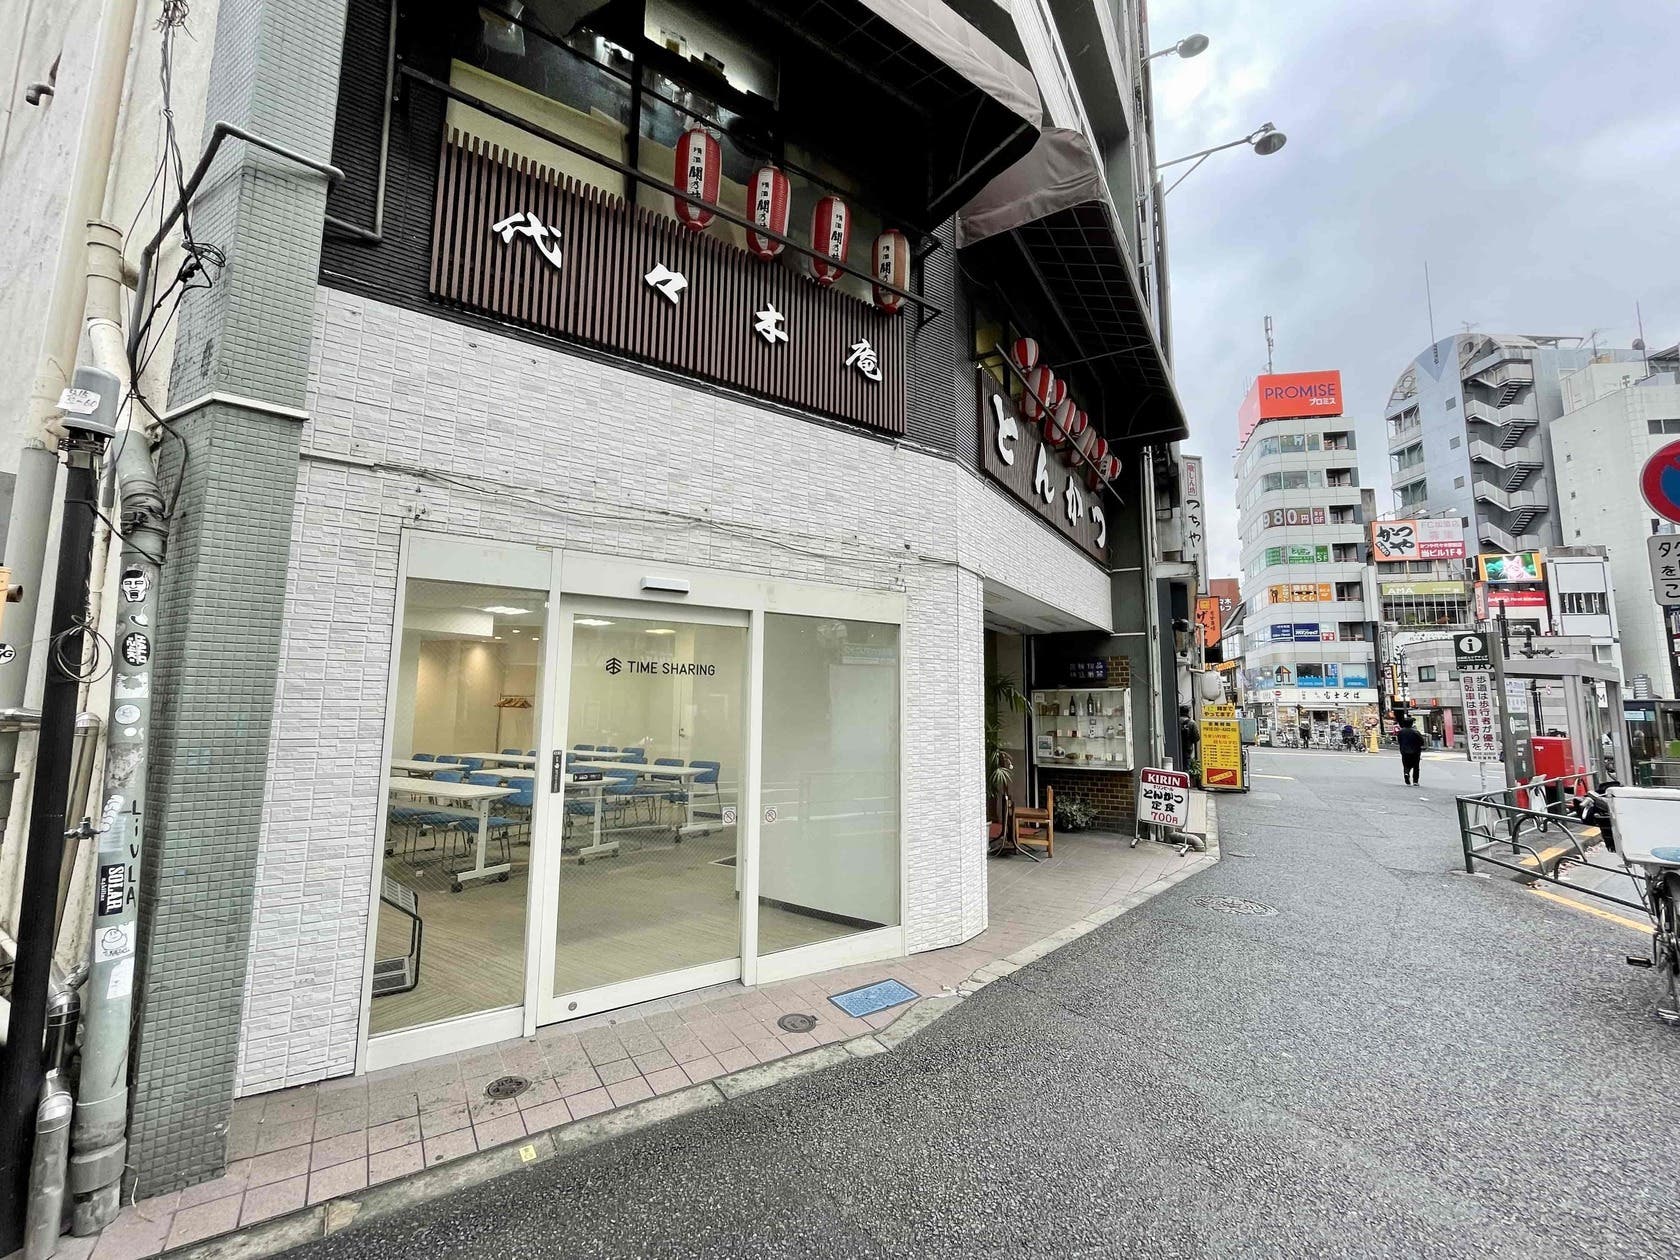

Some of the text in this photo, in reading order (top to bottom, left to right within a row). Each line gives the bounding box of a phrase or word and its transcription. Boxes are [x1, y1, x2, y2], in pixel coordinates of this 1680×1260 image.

[1264, 383, 1336, 400] PROMISE
[1309, 397, 1337, 406] プロミス
[991, 393, 1107, 549] とんかつ
[1376, 525, 1416, 554] かつや
[627, 660, 716, 676] TIME SHARING
[1463, 675, 1482, 751] 自転車は車道寄りを
[1476, 675, 1495, 751] 歩道は歩行者が優先
[1147, 773, 1182, 787] KIRIN
[1143, 788, 1184, 805] とんかつ
[1151, 800, 1176, 813] 定食
[1150, 810, 1179, 825] 700円
[106, 865, 125, 914] SOLAR
